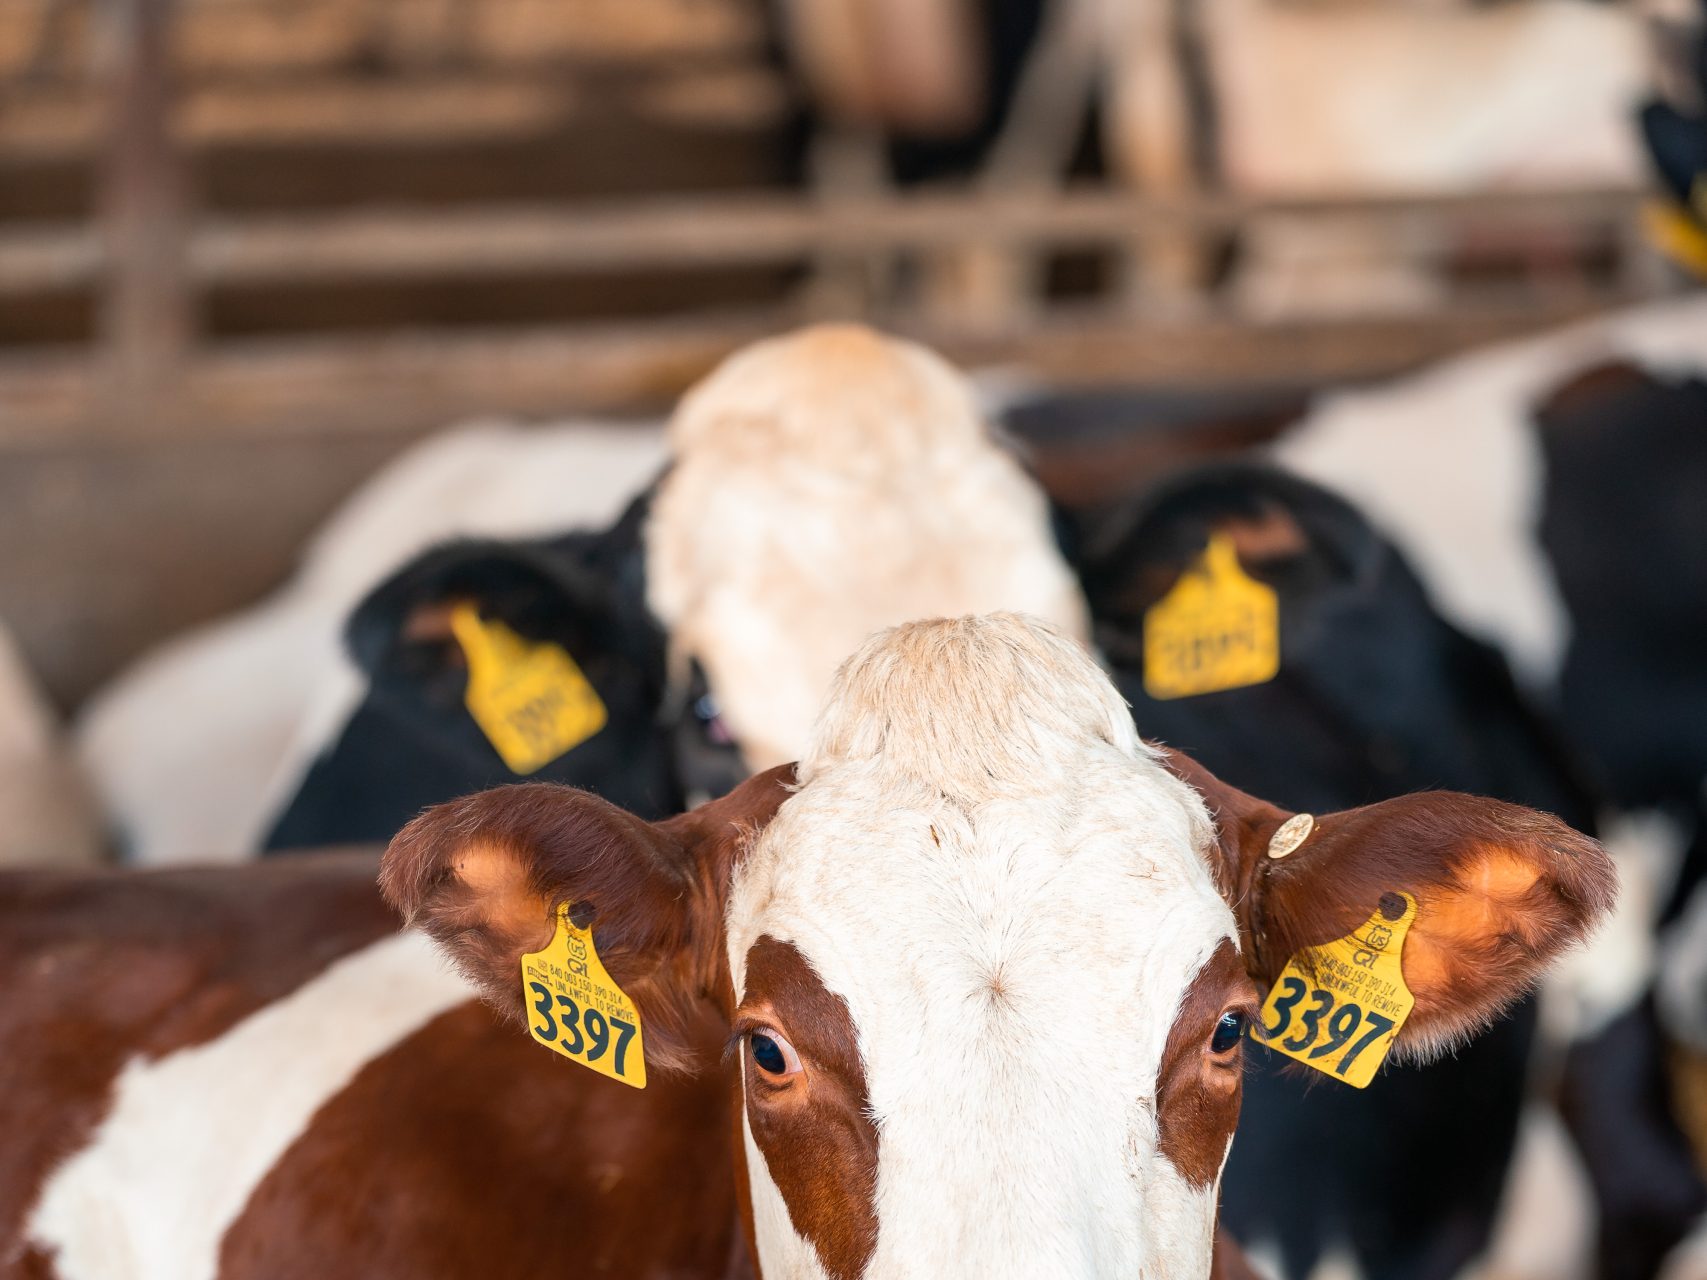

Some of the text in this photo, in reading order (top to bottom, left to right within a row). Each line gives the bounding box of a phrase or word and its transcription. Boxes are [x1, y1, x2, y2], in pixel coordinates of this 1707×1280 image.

[1371, 934, 1386, 947] US
[549, 963, 563, 979] 840
[564, 970, 577, 986] 003
[578, 977, 592, 993] 150
[593, 984, 607, 1000] 390
[609, 990, 622, 1005] 314
[555, 979, 635, 1024] UNLAWFUL TO REMOVE
[1351, 971, 1368, 984] 150
[1366, 975, 1382, 991] 390
[1380, 981, 1398, 997] 314
[1361, 989, 1374, 1004] TO
[1372, 994, 1403, 1017] REMOVE
[529, 981, 637, 1077] 3397
[1264, 977, 1396, 1077] 3397
